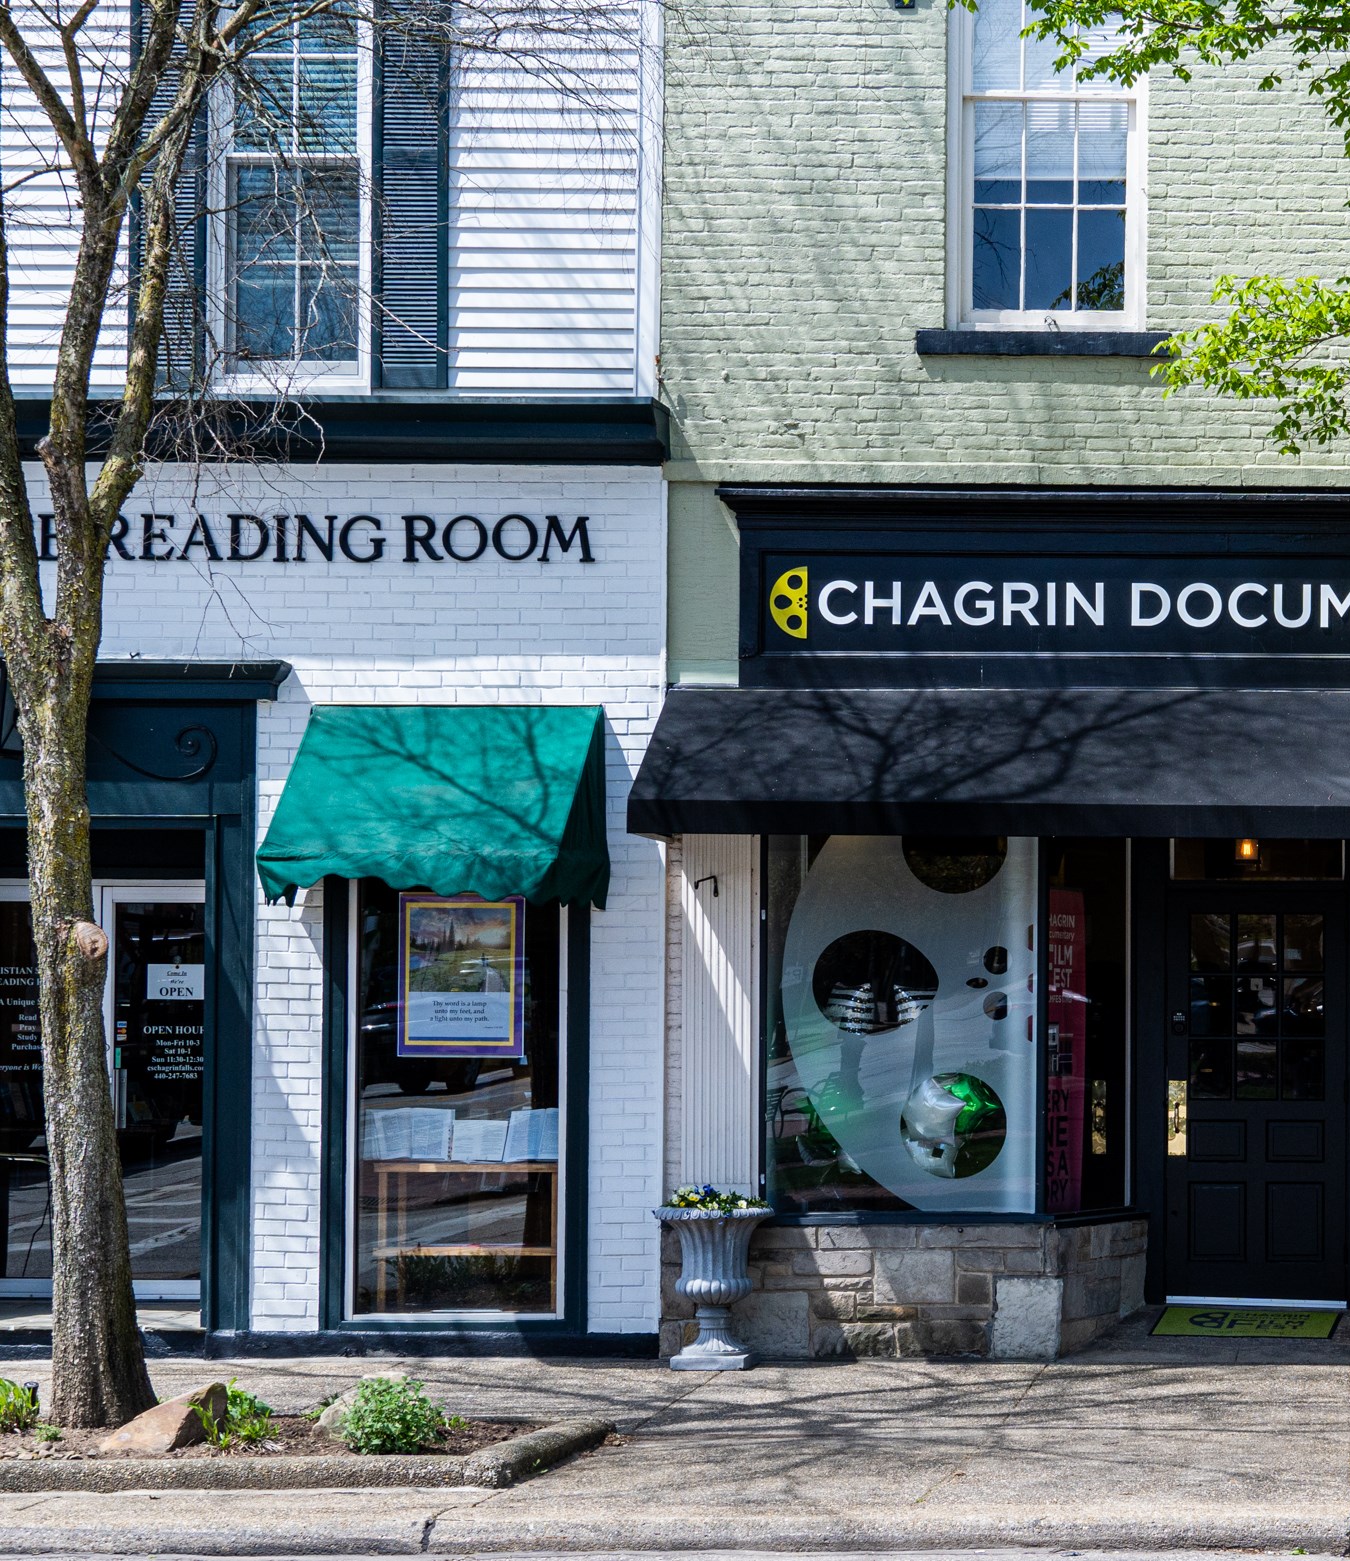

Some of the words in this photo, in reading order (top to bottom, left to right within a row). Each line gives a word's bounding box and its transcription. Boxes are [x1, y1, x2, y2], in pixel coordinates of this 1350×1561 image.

[104, 512, 387, 563] READING
[401, 514, 597, 564] ROOM
[817, 579, 1105, 627] CHAGRIN
[0, 966, 34, 975] ISTIAN
[159, 987, 194, 997] OPEN
[6, 998, 36, 1008] Unique
[432, 1000, 443, 1008] Thy
[472, 1000, 487, 1008] lamp
[18, 1013, 37, 1021] Read
[19, 1024, 37, 1033] Pray
[143, 1025, 173, 1035] OPEN
[17, 1034, 38, 1042] Study
[11, 1043, 43, 1051] Purchas
[155, 1039, 185, 1047] Mon-Fri
[186, 1039, 201, 1047] 10-3
[23, 1063, 30, 1071] is
